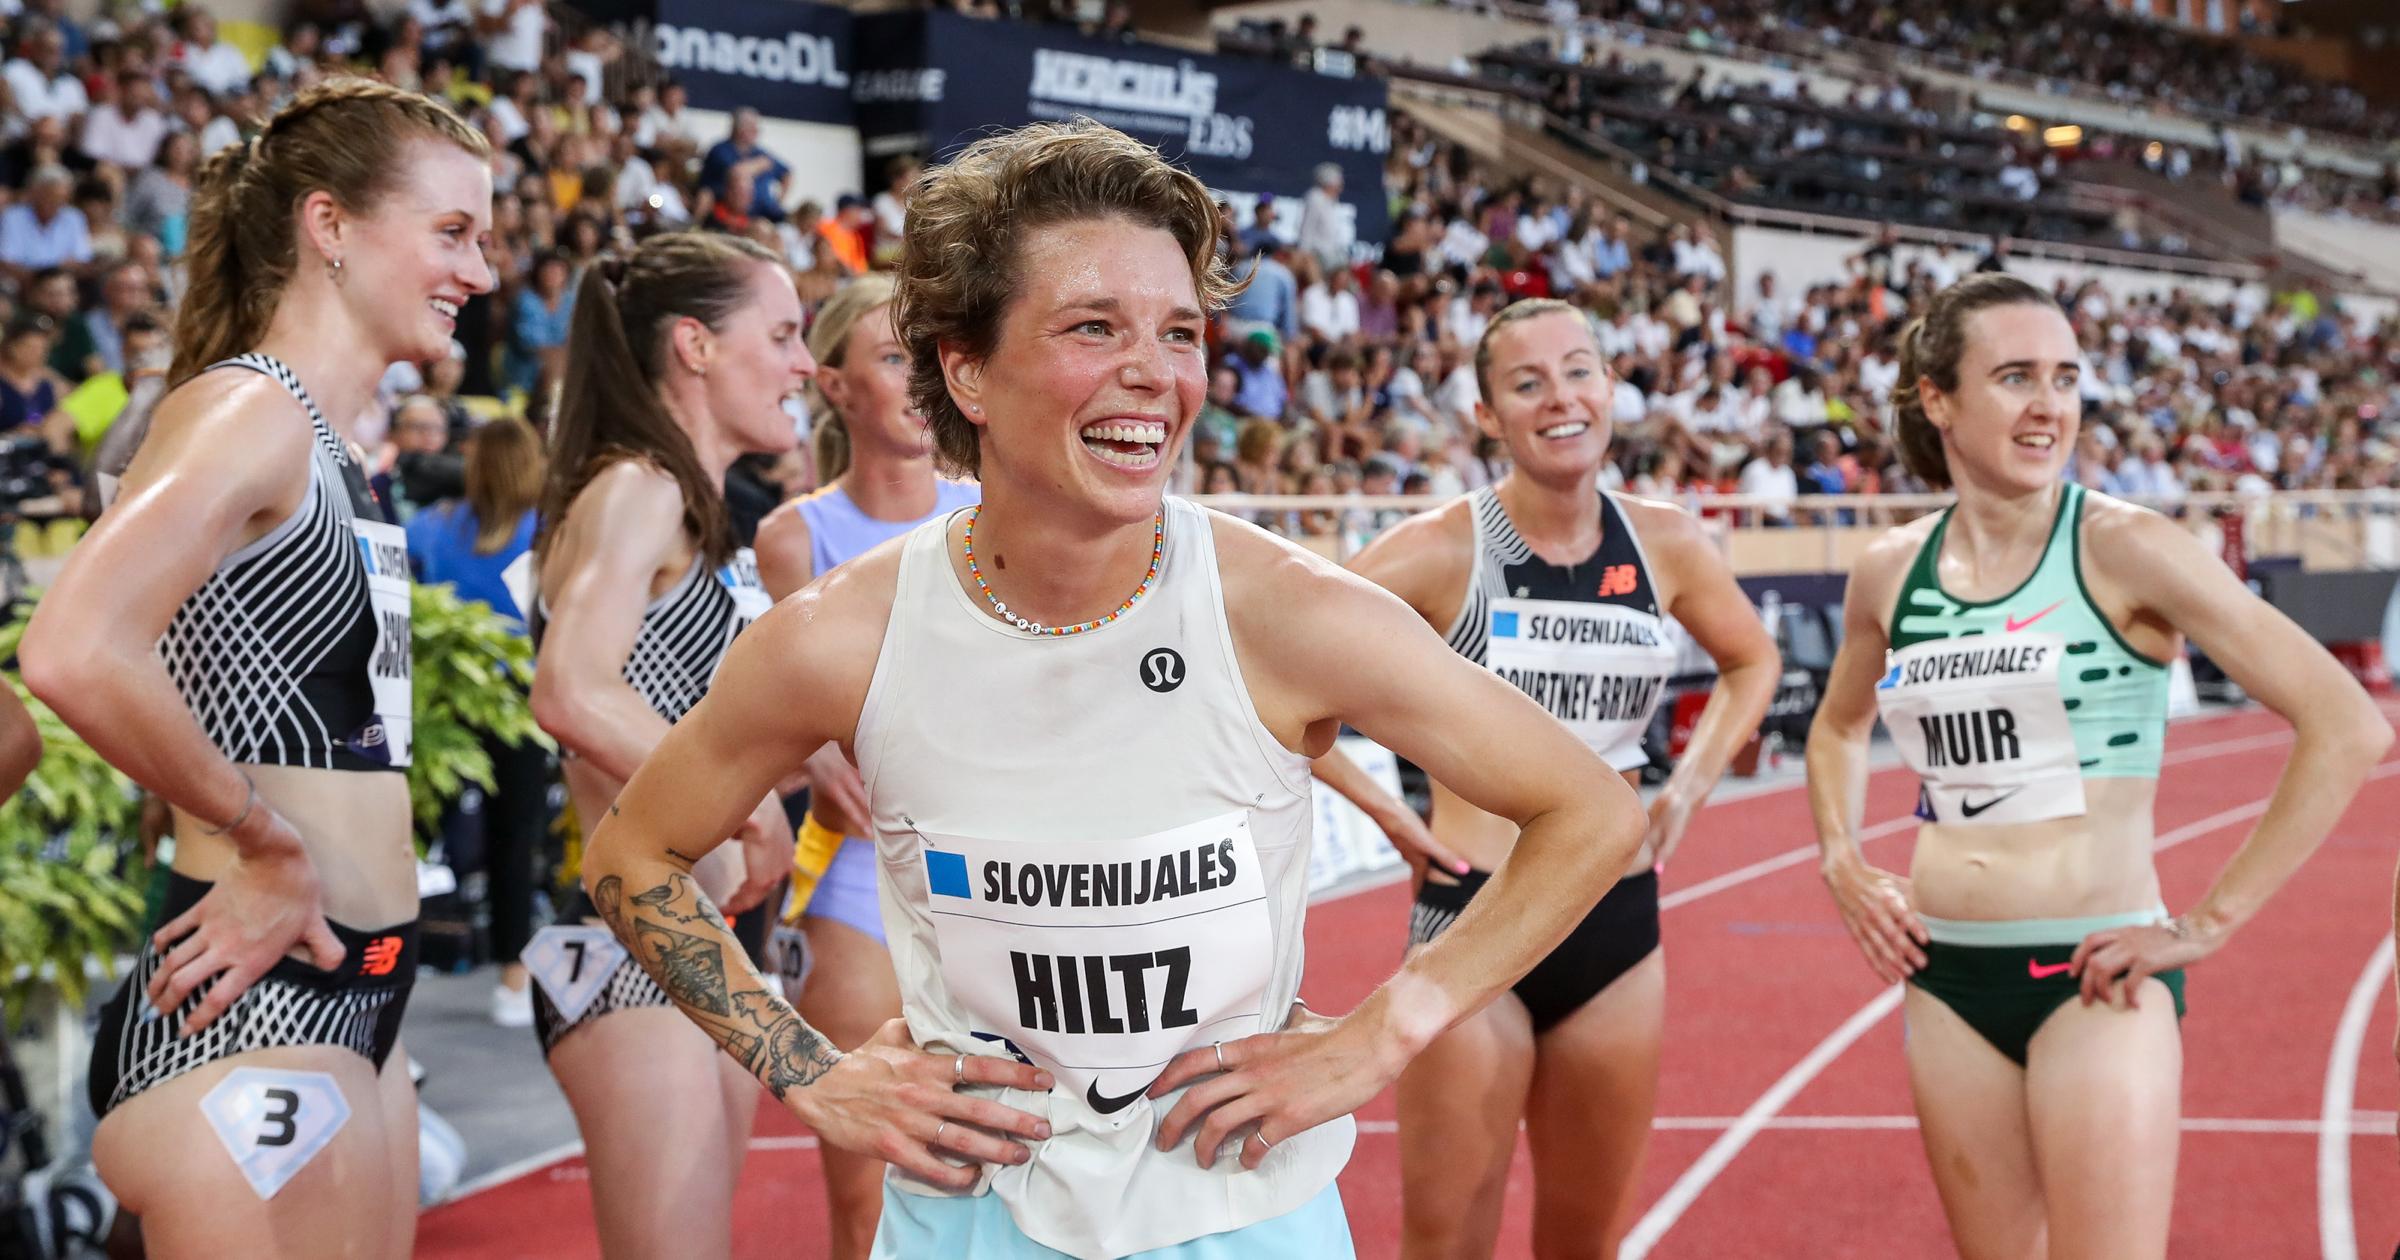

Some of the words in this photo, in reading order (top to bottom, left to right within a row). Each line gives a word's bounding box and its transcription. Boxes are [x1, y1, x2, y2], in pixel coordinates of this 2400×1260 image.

[652, 22, 851, 90] onacoDL
[1495, 667, 1662, 721] URTNEY-BRYANT
[1904, 646, 2047, 687] SLOVENIJALES
[1918, 708, 2021, 768] MUIR
[983, 837, 1238, 908] SLOVENIJALES
[563, 941, 586, 984] 7
[1009, 945, 1199, 1034] HILTZ
[256, 1088, 300, 1147] 3
